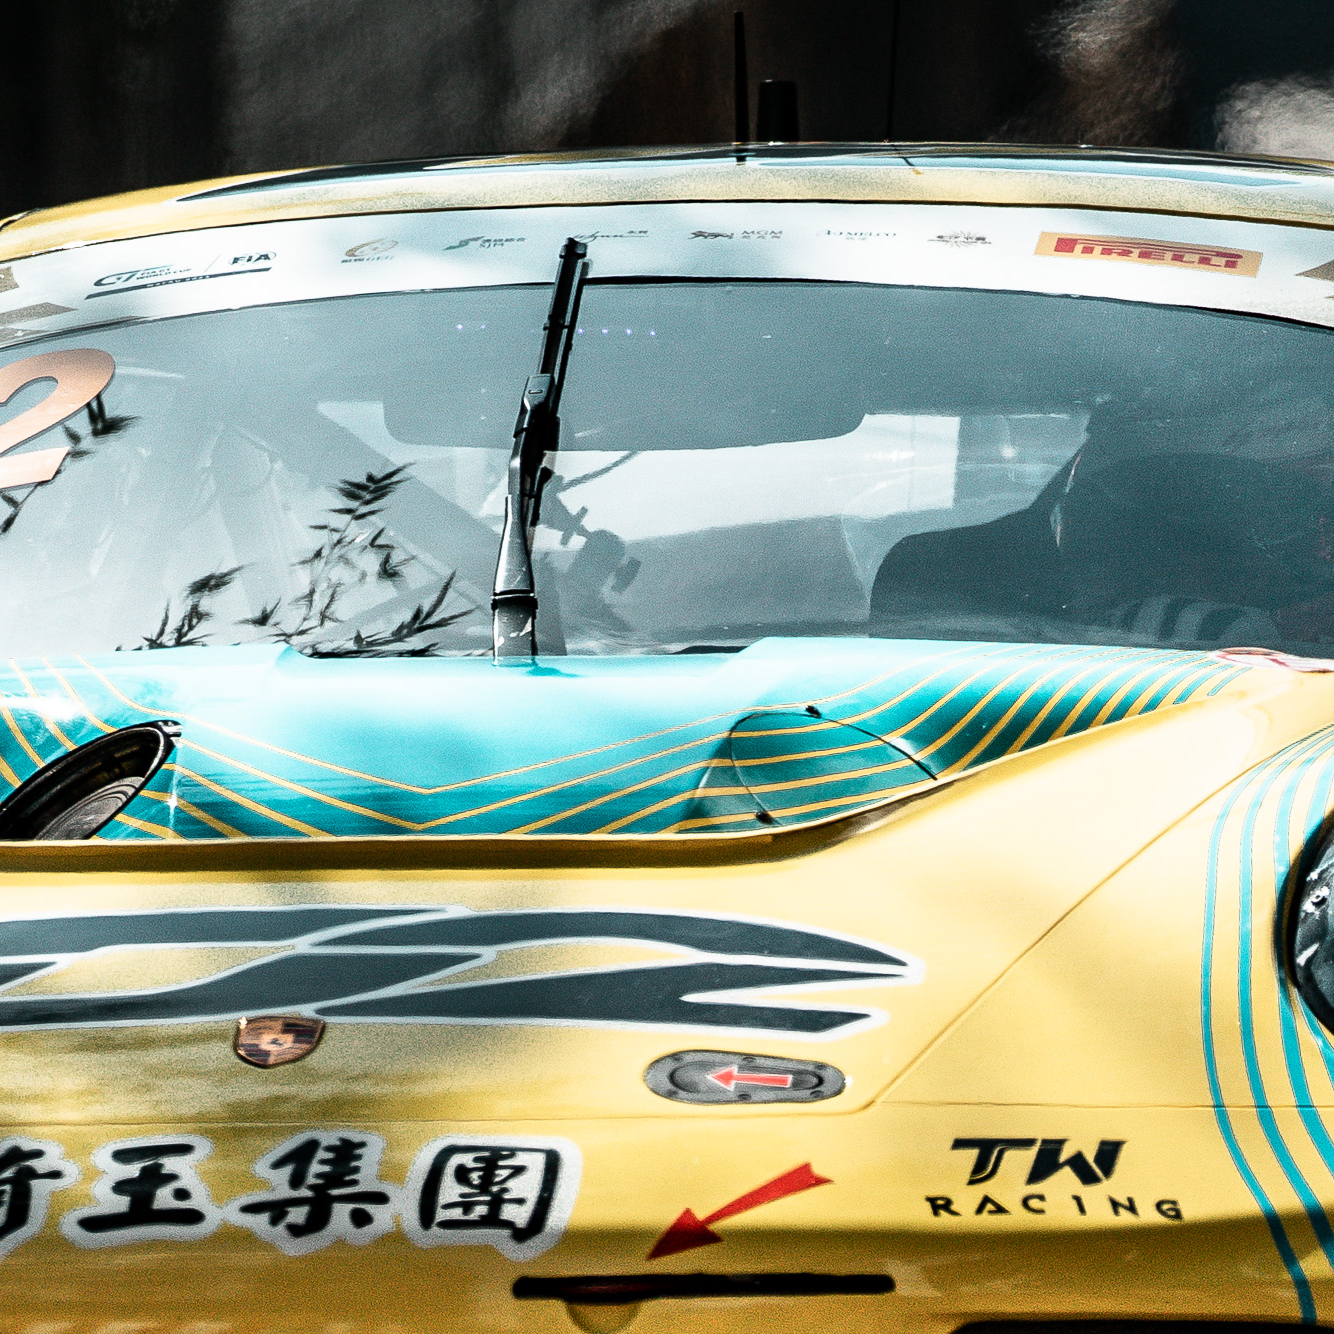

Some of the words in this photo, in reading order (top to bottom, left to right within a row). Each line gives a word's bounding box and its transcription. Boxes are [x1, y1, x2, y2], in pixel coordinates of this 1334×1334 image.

[230, 252, 271, 266] FIA
[1053, 238, 1243, 268] PIRELLI
[950, 1136, 1129, 1187] TW
[925, 1194, 1184, 1221] RACING
